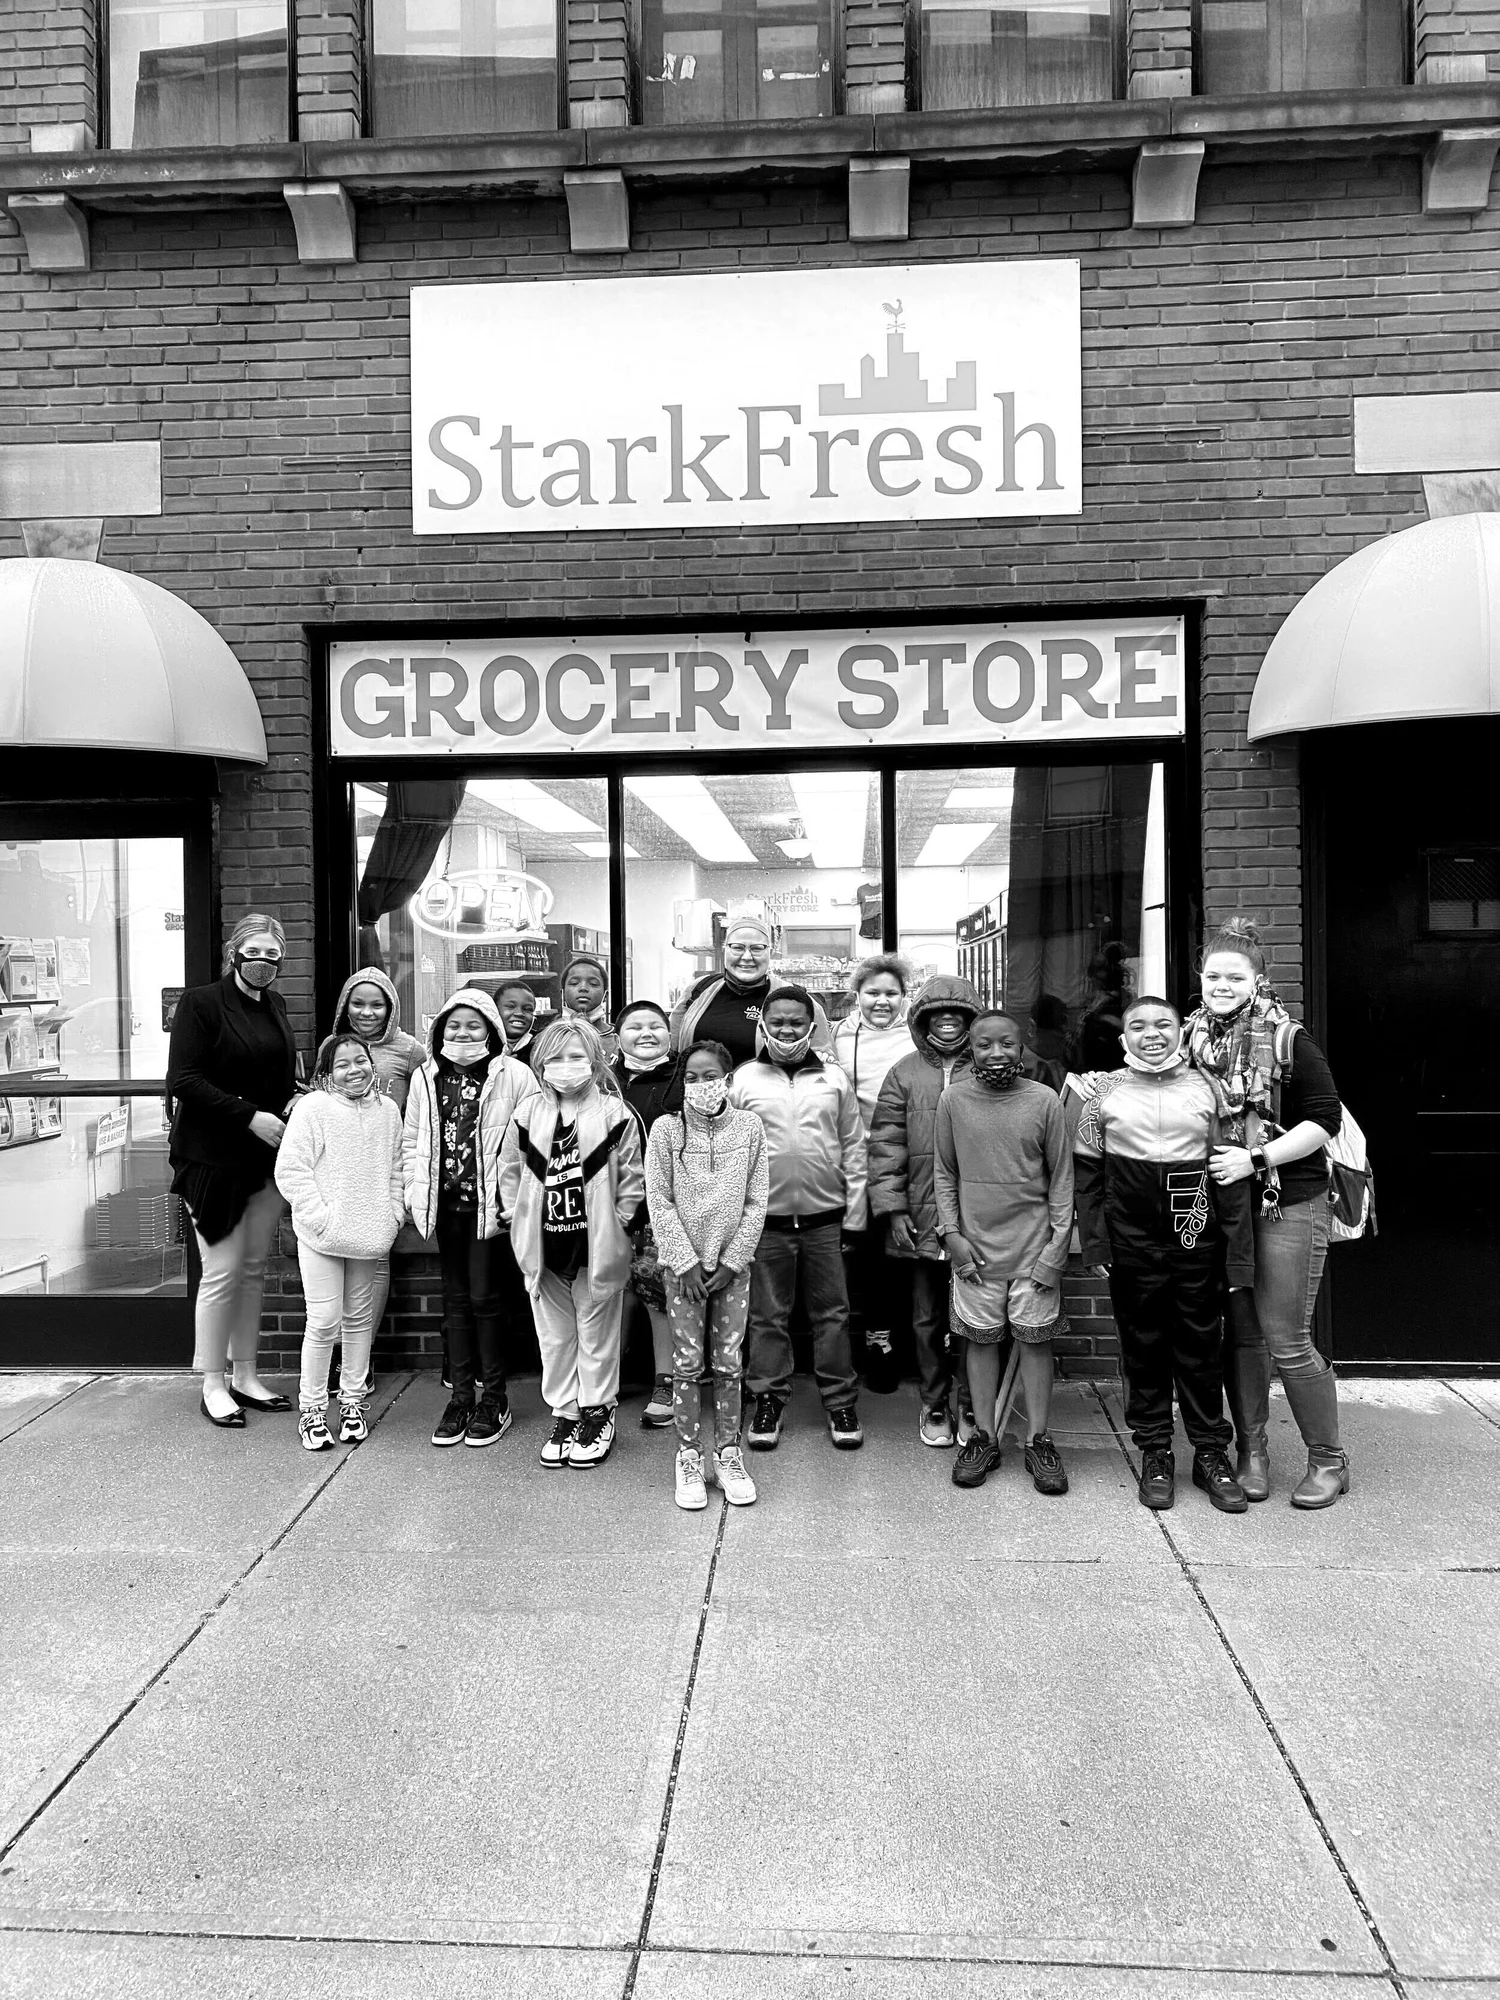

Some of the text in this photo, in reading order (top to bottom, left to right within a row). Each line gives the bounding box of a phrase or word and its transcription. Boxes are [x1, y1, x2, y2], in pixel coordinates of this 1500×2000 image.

[427, 391, 1065, 511] StarkFresh
[340, 635, 1178, 739] GROCERY STORE
[419, 879, 544, 929] OPEN
[547, 1186, 588, 1221] RE
